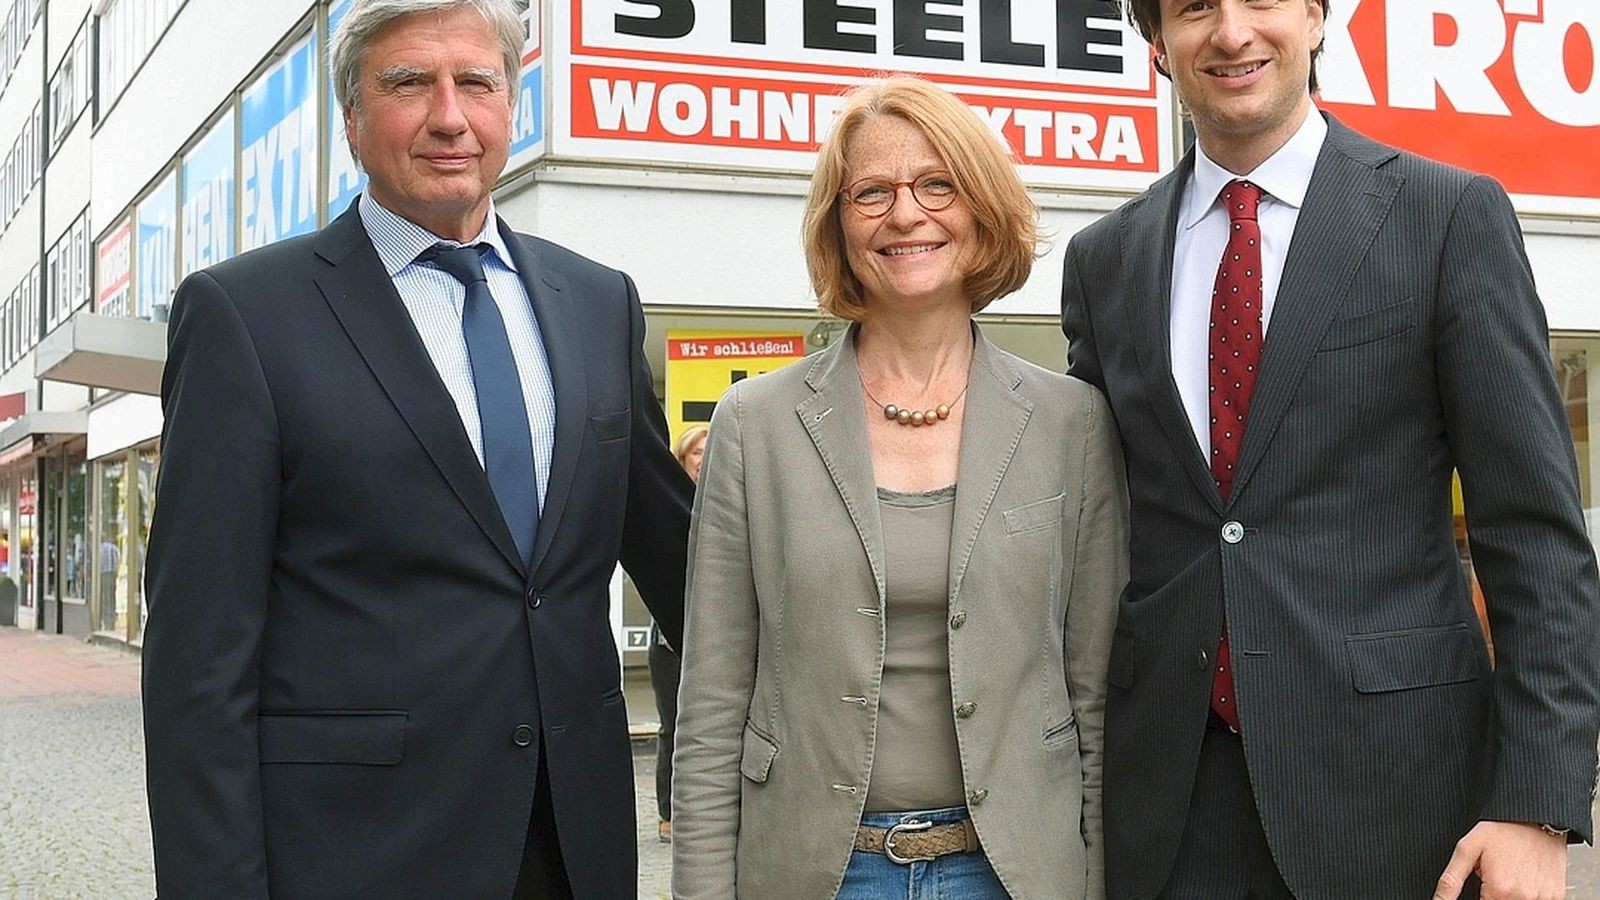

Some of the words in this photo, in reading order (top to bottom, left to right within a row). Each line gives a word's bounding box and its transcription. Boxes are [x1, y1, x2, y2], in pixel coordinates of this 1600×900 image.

[615, 0, 1123, 74] STEELE
[588, 77, 848, 144] WOHNE
[968, 104, 1145, 164] XTRA
[680, 342, 708, 357] Wir
[714, 340, 794, 356] schließen!
[633, 633, 644, 645] 7
